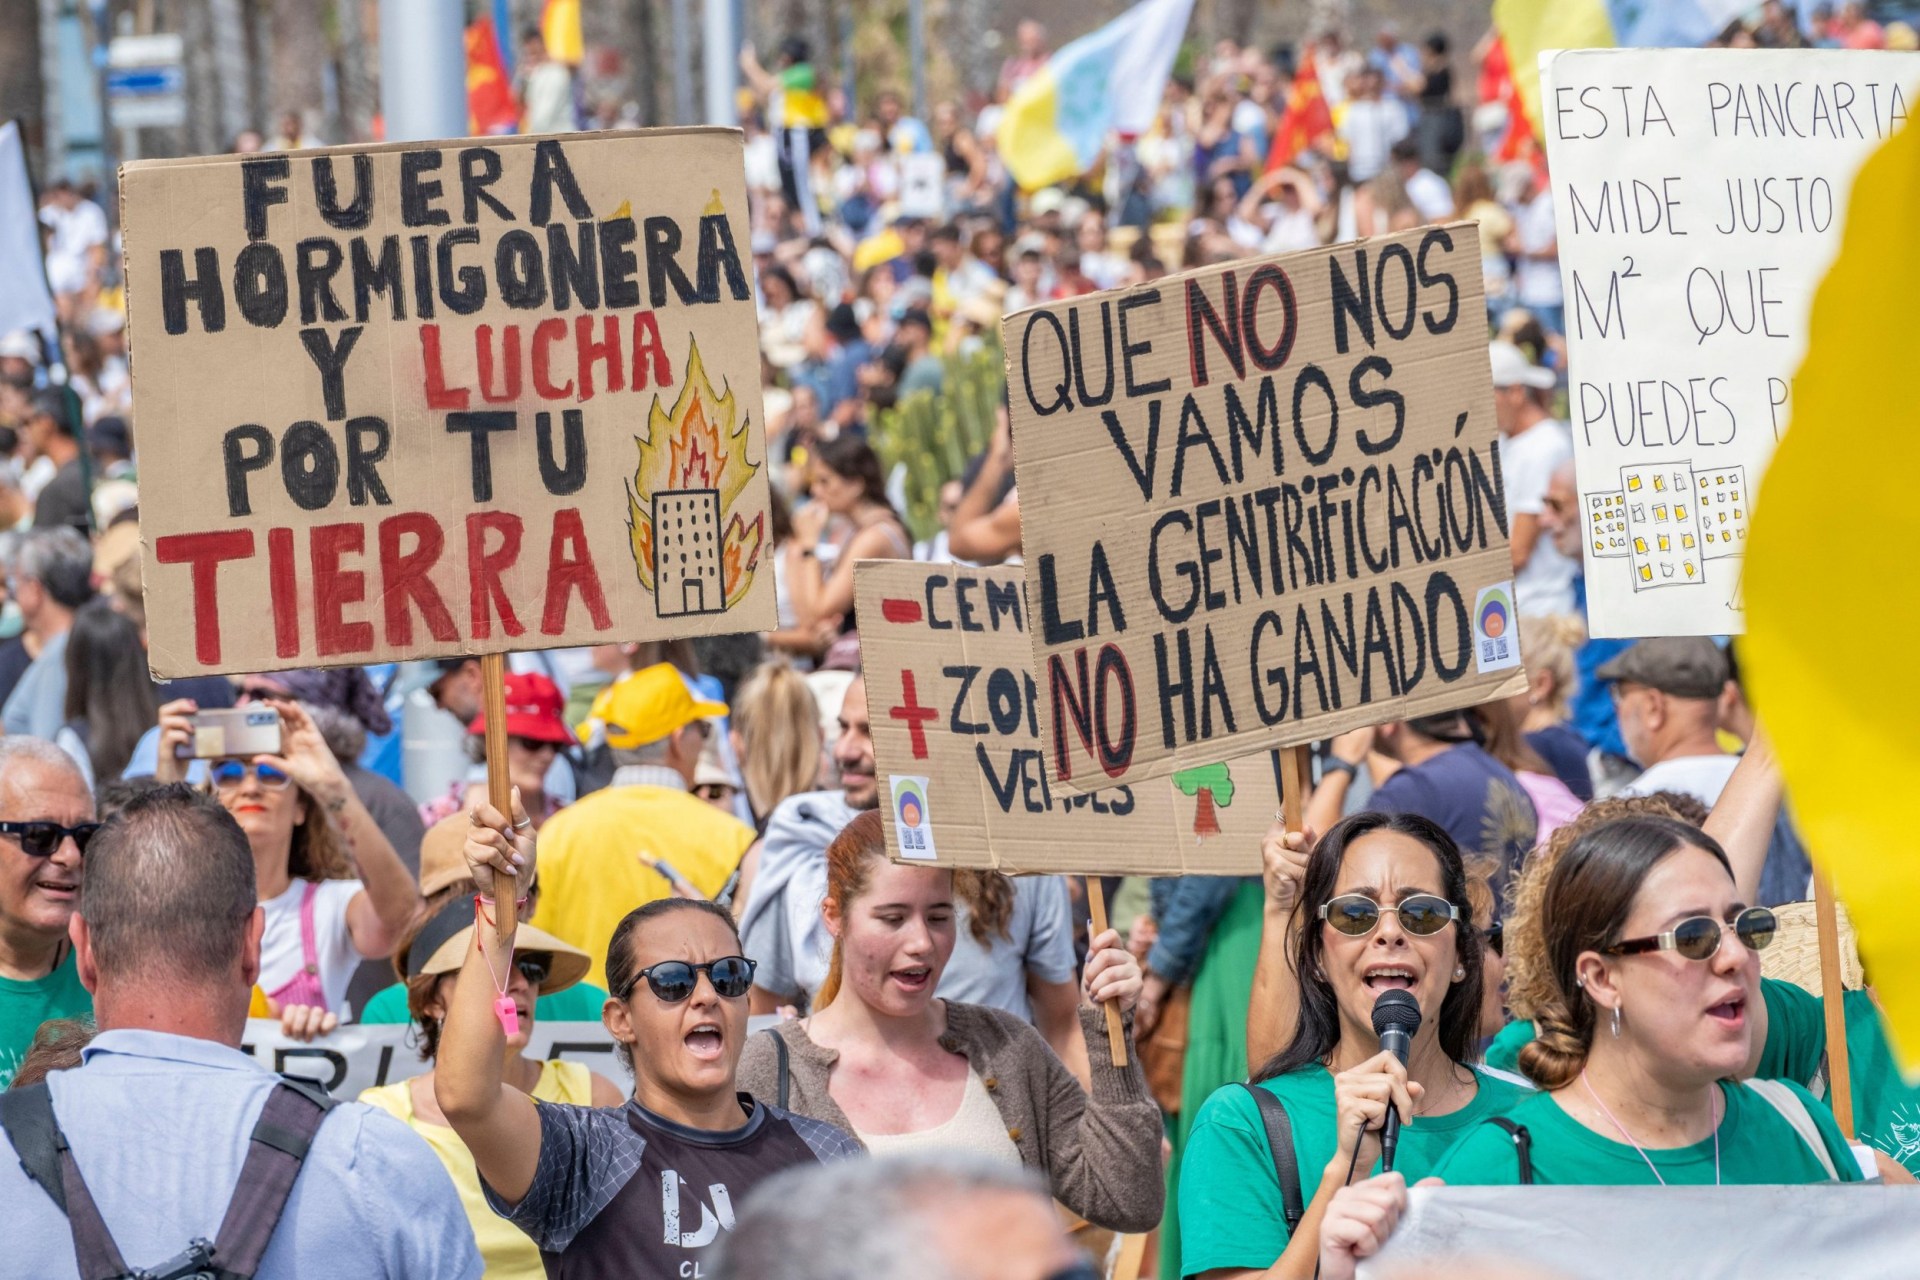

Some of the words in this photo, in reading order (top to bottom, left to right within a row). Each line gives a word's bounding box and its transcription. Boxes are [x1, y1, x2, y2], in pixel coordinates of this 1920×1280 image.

[1555, 85, 1676, 140] ESTA
[1707, 82, 1909, 140] PANCARTA
[241, 140, 595, 241] FUERA
[1569, 177, 1688, 235] MIDE
[1716, 177, 1832, 234] JUSTO
[159, 214, 752, 336] HORMIGONERA
[1020, 289, 1171, 416] QUE
[1184, 263, 1298, 388] NO
[1329, 229, 1460, 354] NOS
[1687, 267, 1789, 345] QUE
[300, 325, 364, 422] Y
[418, 310, 674, 410] LUCHA
[1580, 377, 1736, 447] PUEDES
[1767, 377, 1795, 444] P
[222, 415, 393, 517] POR
[445, 408, 589, 503] TU
[1102, 356, 1405, 502] VAMOS
[155, 508, 614, 665] TIERRA
[925, 575, 1031, 632] CEM
[1038, 540, 1128, 645] LA
[1047, 641, 1137, 781] NO
[1153, 623, 1238, 748] HA
[1250, 570, 1473, 728] GANADO
[975, 741, 1135, 815] VES
